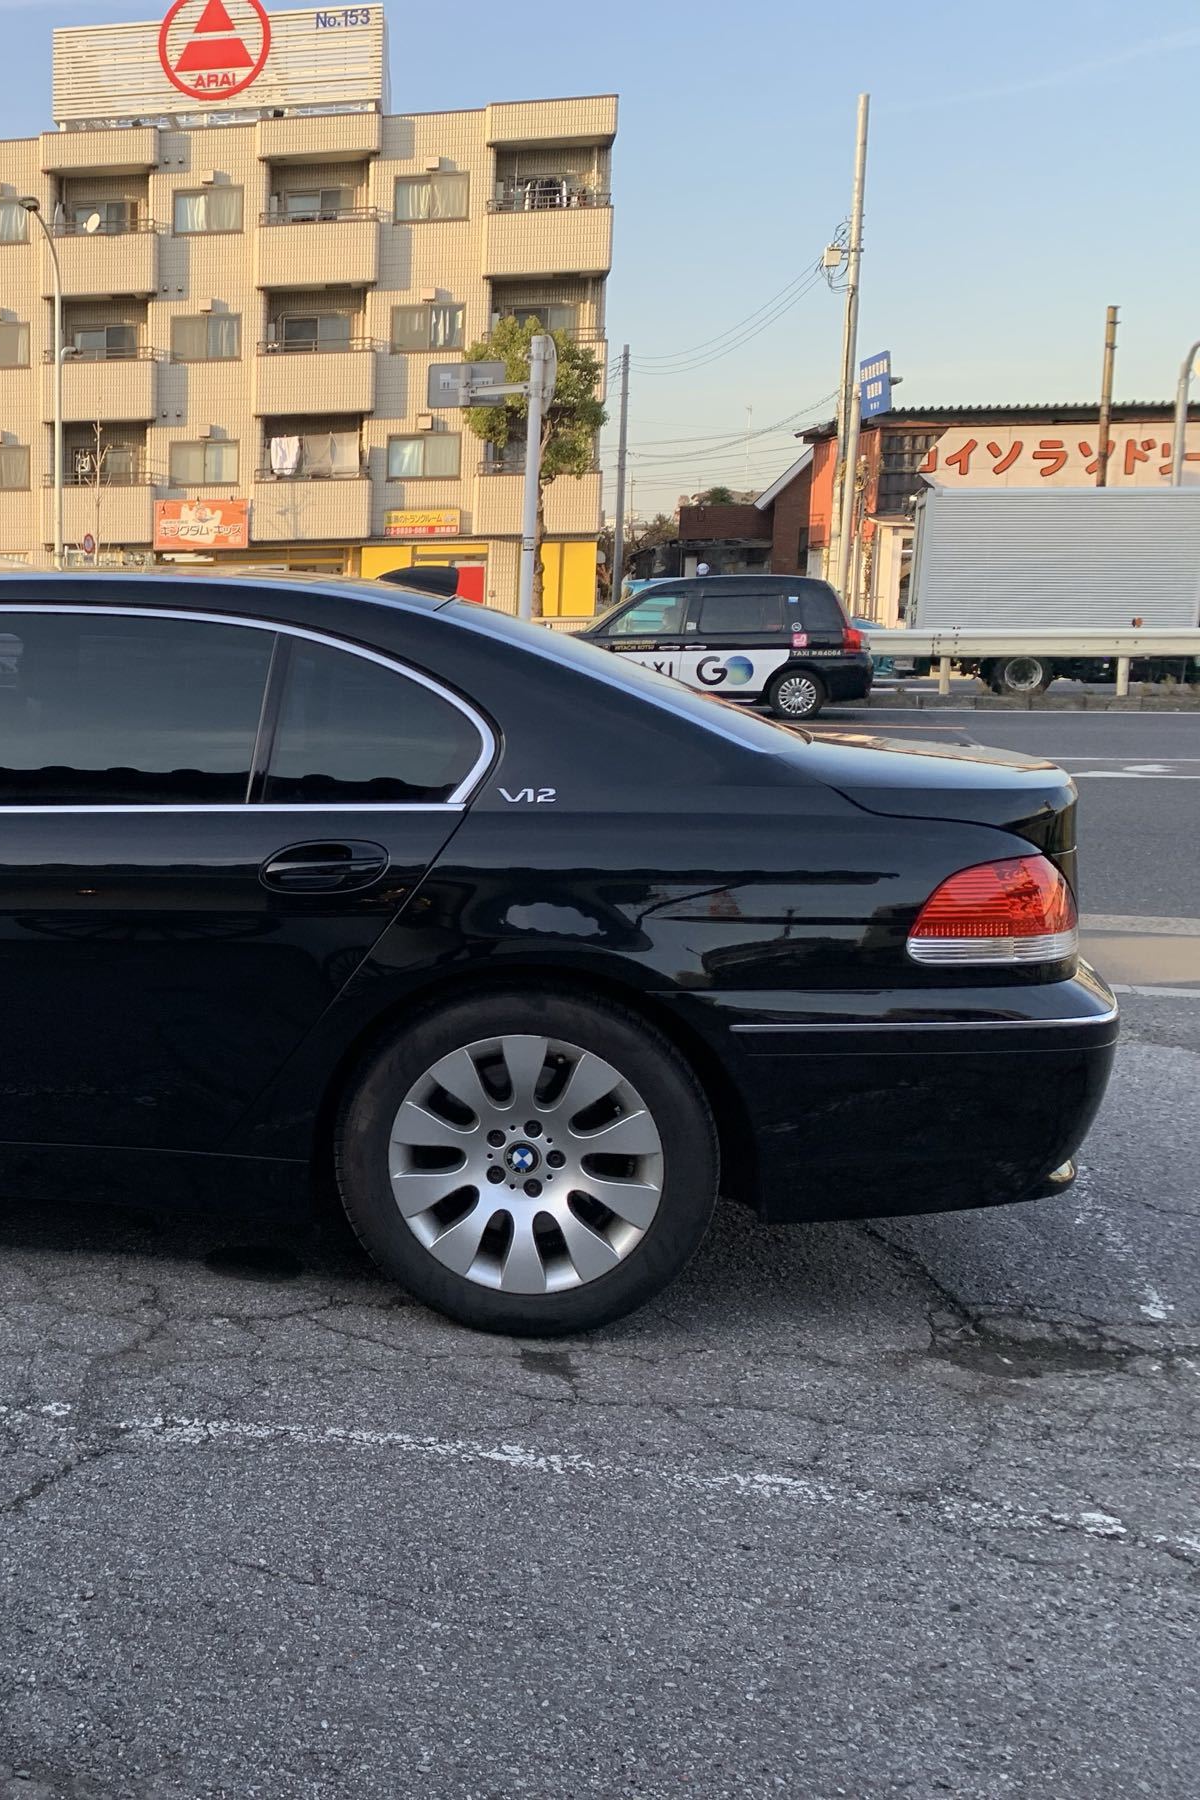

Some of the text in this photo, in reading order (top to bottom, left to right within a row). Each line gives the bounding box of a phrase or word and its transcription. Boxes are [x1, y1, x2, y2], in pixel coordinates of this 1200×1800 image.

[315, 8, 371, 29] No.153
[194, 73, 236, 88] ARAI
[497, 787, 557, 803] V12
